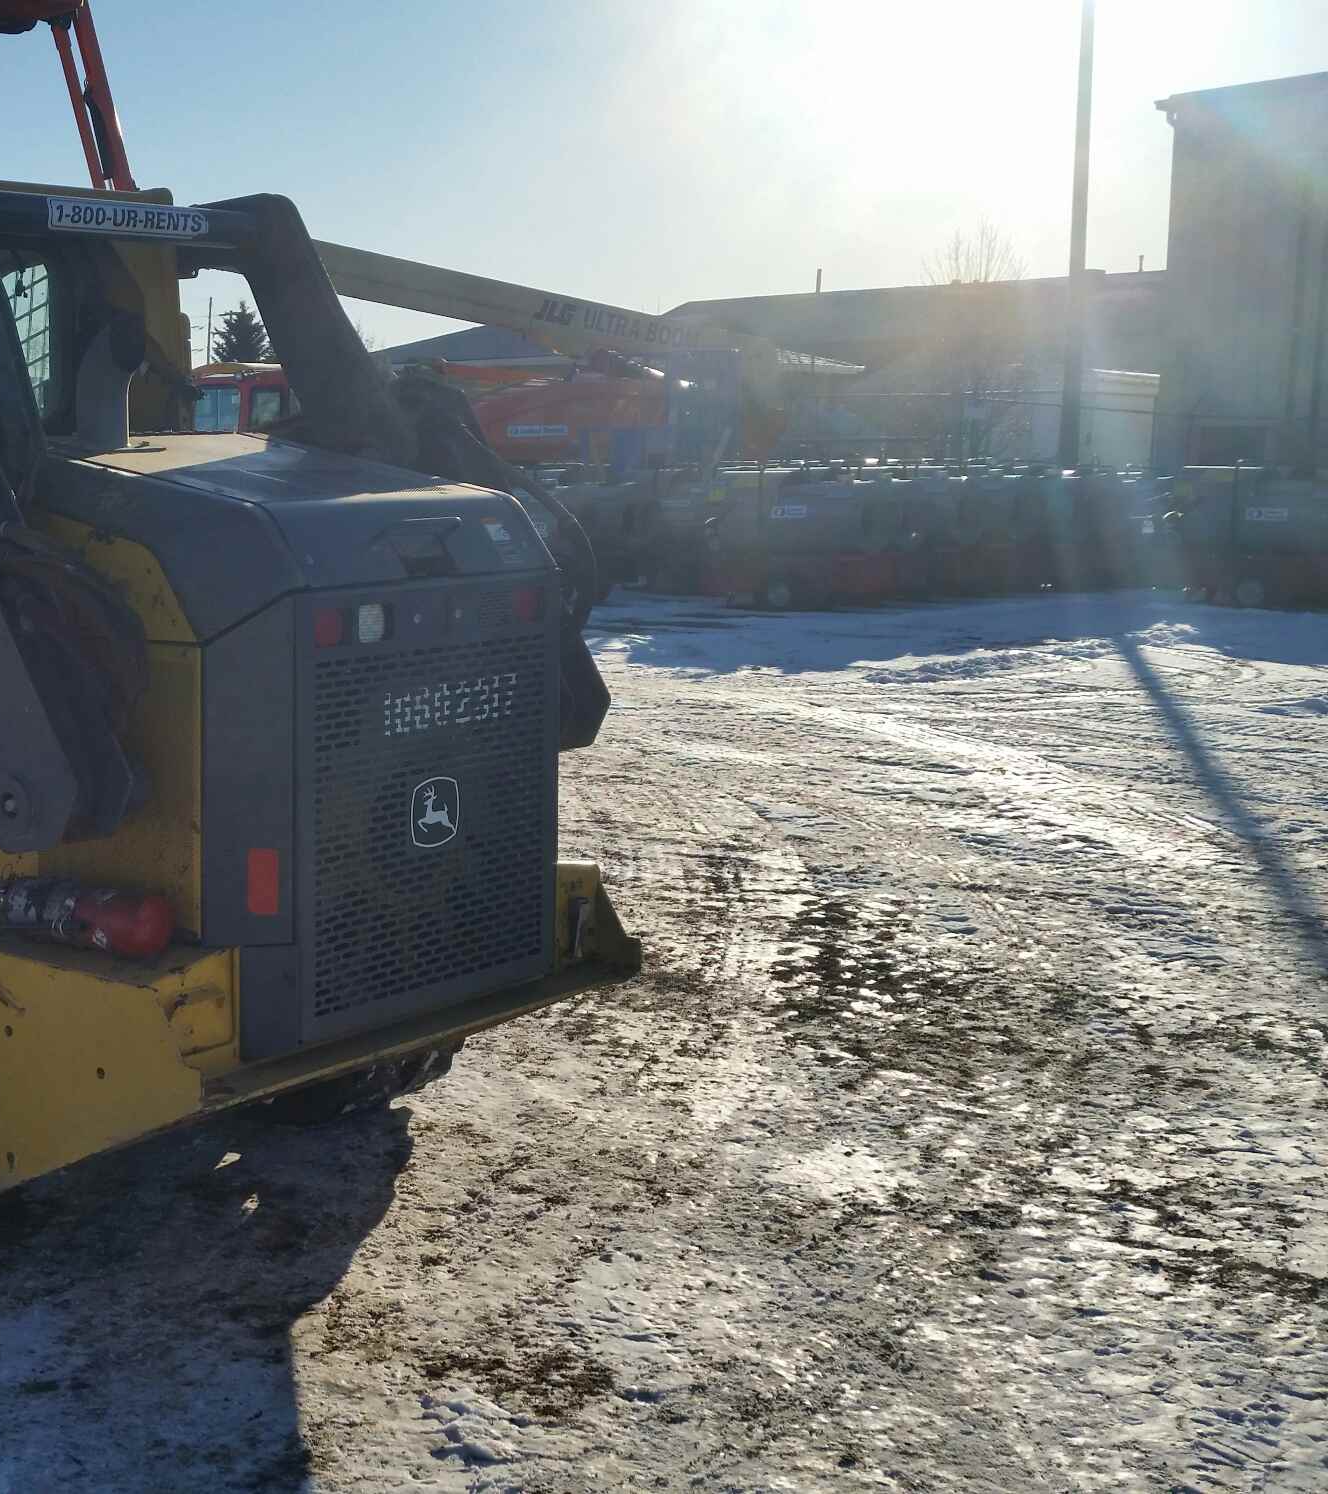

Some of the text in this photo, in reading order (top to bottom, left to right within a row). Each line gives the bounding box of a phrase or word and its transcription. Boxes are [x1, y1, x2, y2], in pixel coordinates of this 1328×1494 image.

[56, 204, 203, 233] 1-800-UR-RENTS
[532, 299, 576, 325] JLG
[583, 306, 640, 340] ULTRA
